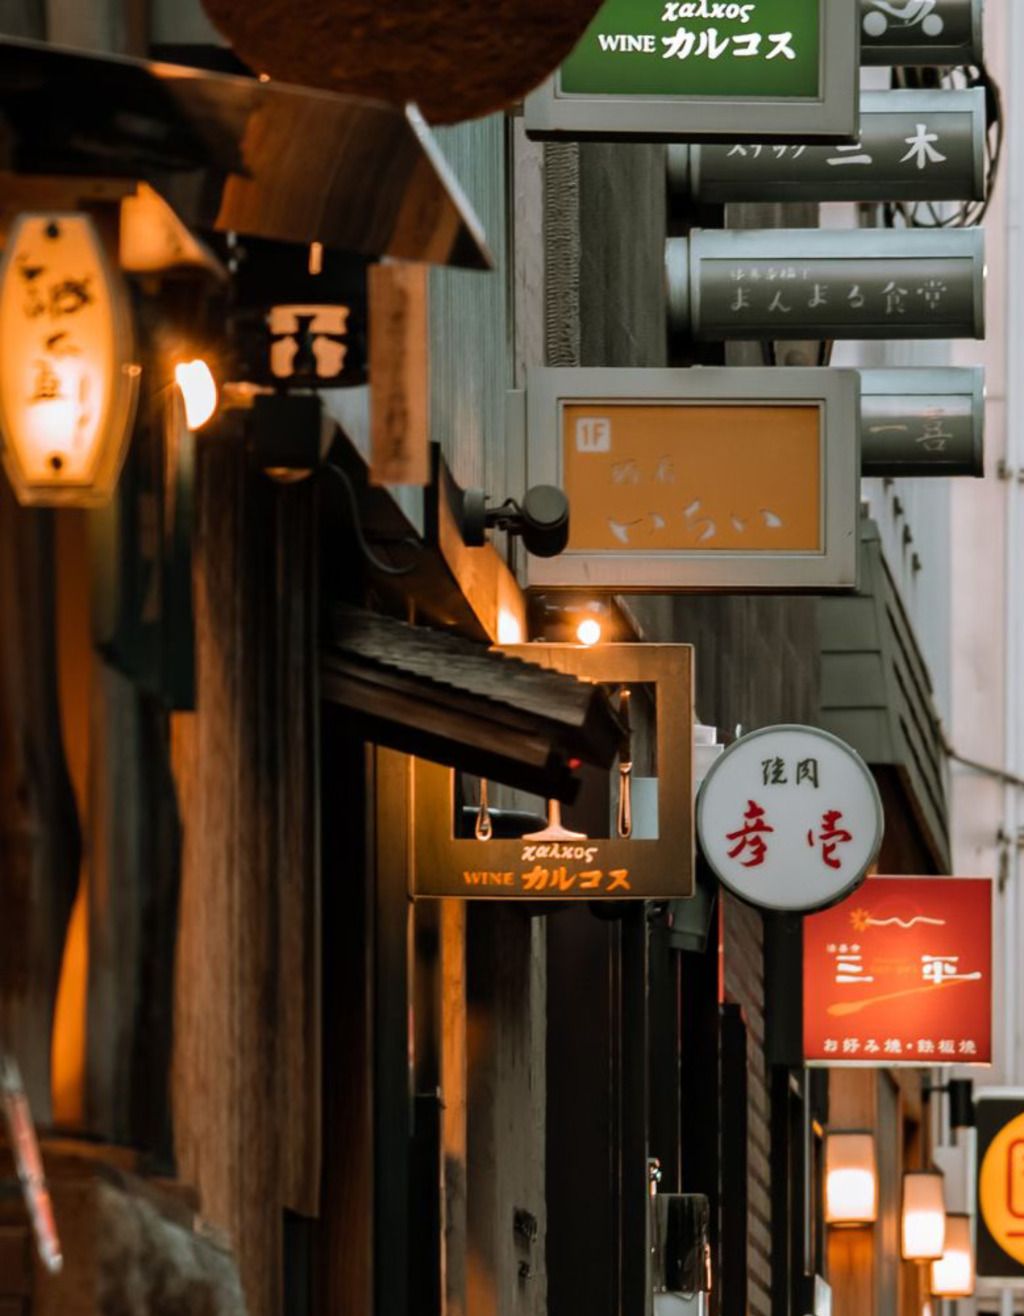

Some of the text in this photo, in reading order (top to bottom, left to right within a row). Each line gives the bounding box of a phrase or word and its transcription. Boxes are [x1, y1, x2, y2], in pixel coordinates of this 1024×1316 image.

[598, 27, 796, 60] WINE カルコス
[463, 865, 631, 891] WINE カルコス
